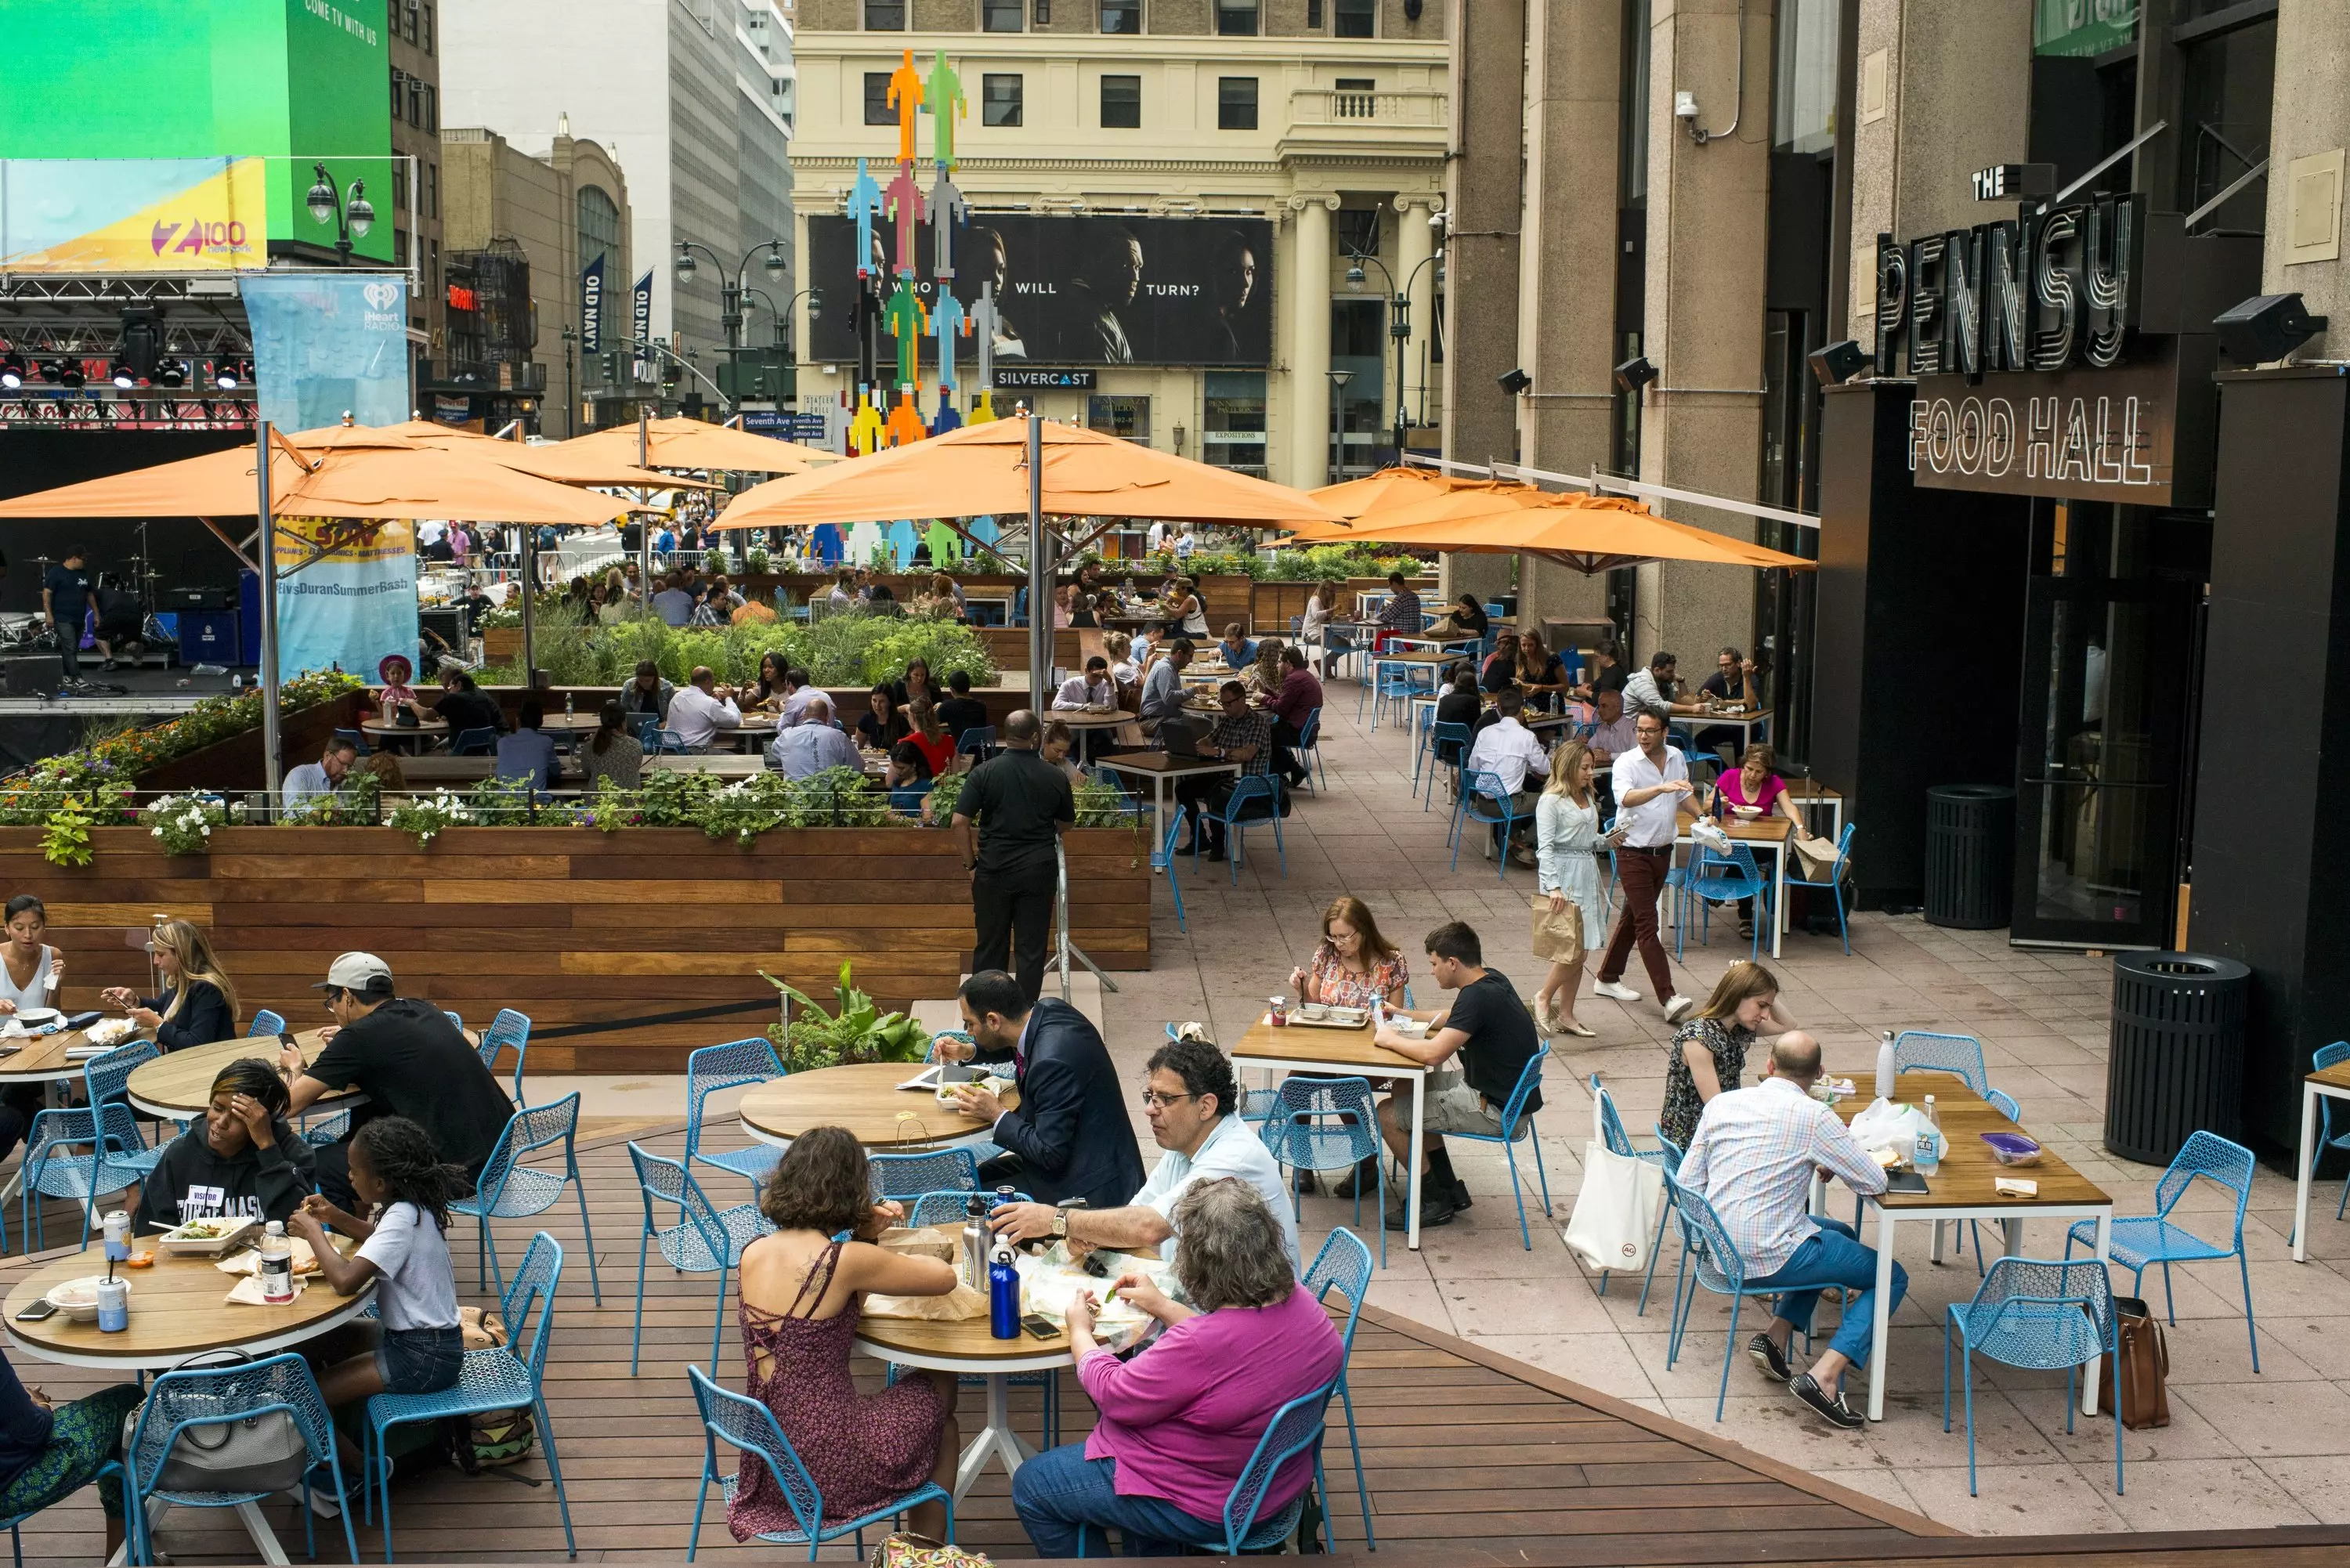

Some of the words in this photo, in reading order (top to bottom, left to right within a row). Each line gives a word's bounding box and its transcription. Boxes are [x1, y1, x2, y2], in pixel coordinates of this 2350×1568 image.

[332, 7, 342, 27] TV
[345, 14, 364, 40] WITH
[367, 27, 377, 46] US
[1972, 165, 2005, 201] THE
[585, 276, 600, 305] OLD
[891, 282, 932, 294] WHO
[1016, 283, 1057, 294] WILL
[1146, 284, 1200, 296] TURN?
[1875, 192, 2143, 376] PENNSY
[364, 312, 399, 322] iHeart
[635, 291, 649, 317] OLD
[363, 322, 400, 331] RADIO
[584, 308, 597, 350] NAVY
[634, 320, 646, 360] NAVY
[746, 417, 775, 425] Seventh
[1909, 396, 2015, 477] FOOD
[2027, 396, 2150, 485] HALL
[1918, 1140, 1932, 1151] POLAR
[193, 1192, 217, 1201] VISITOR
